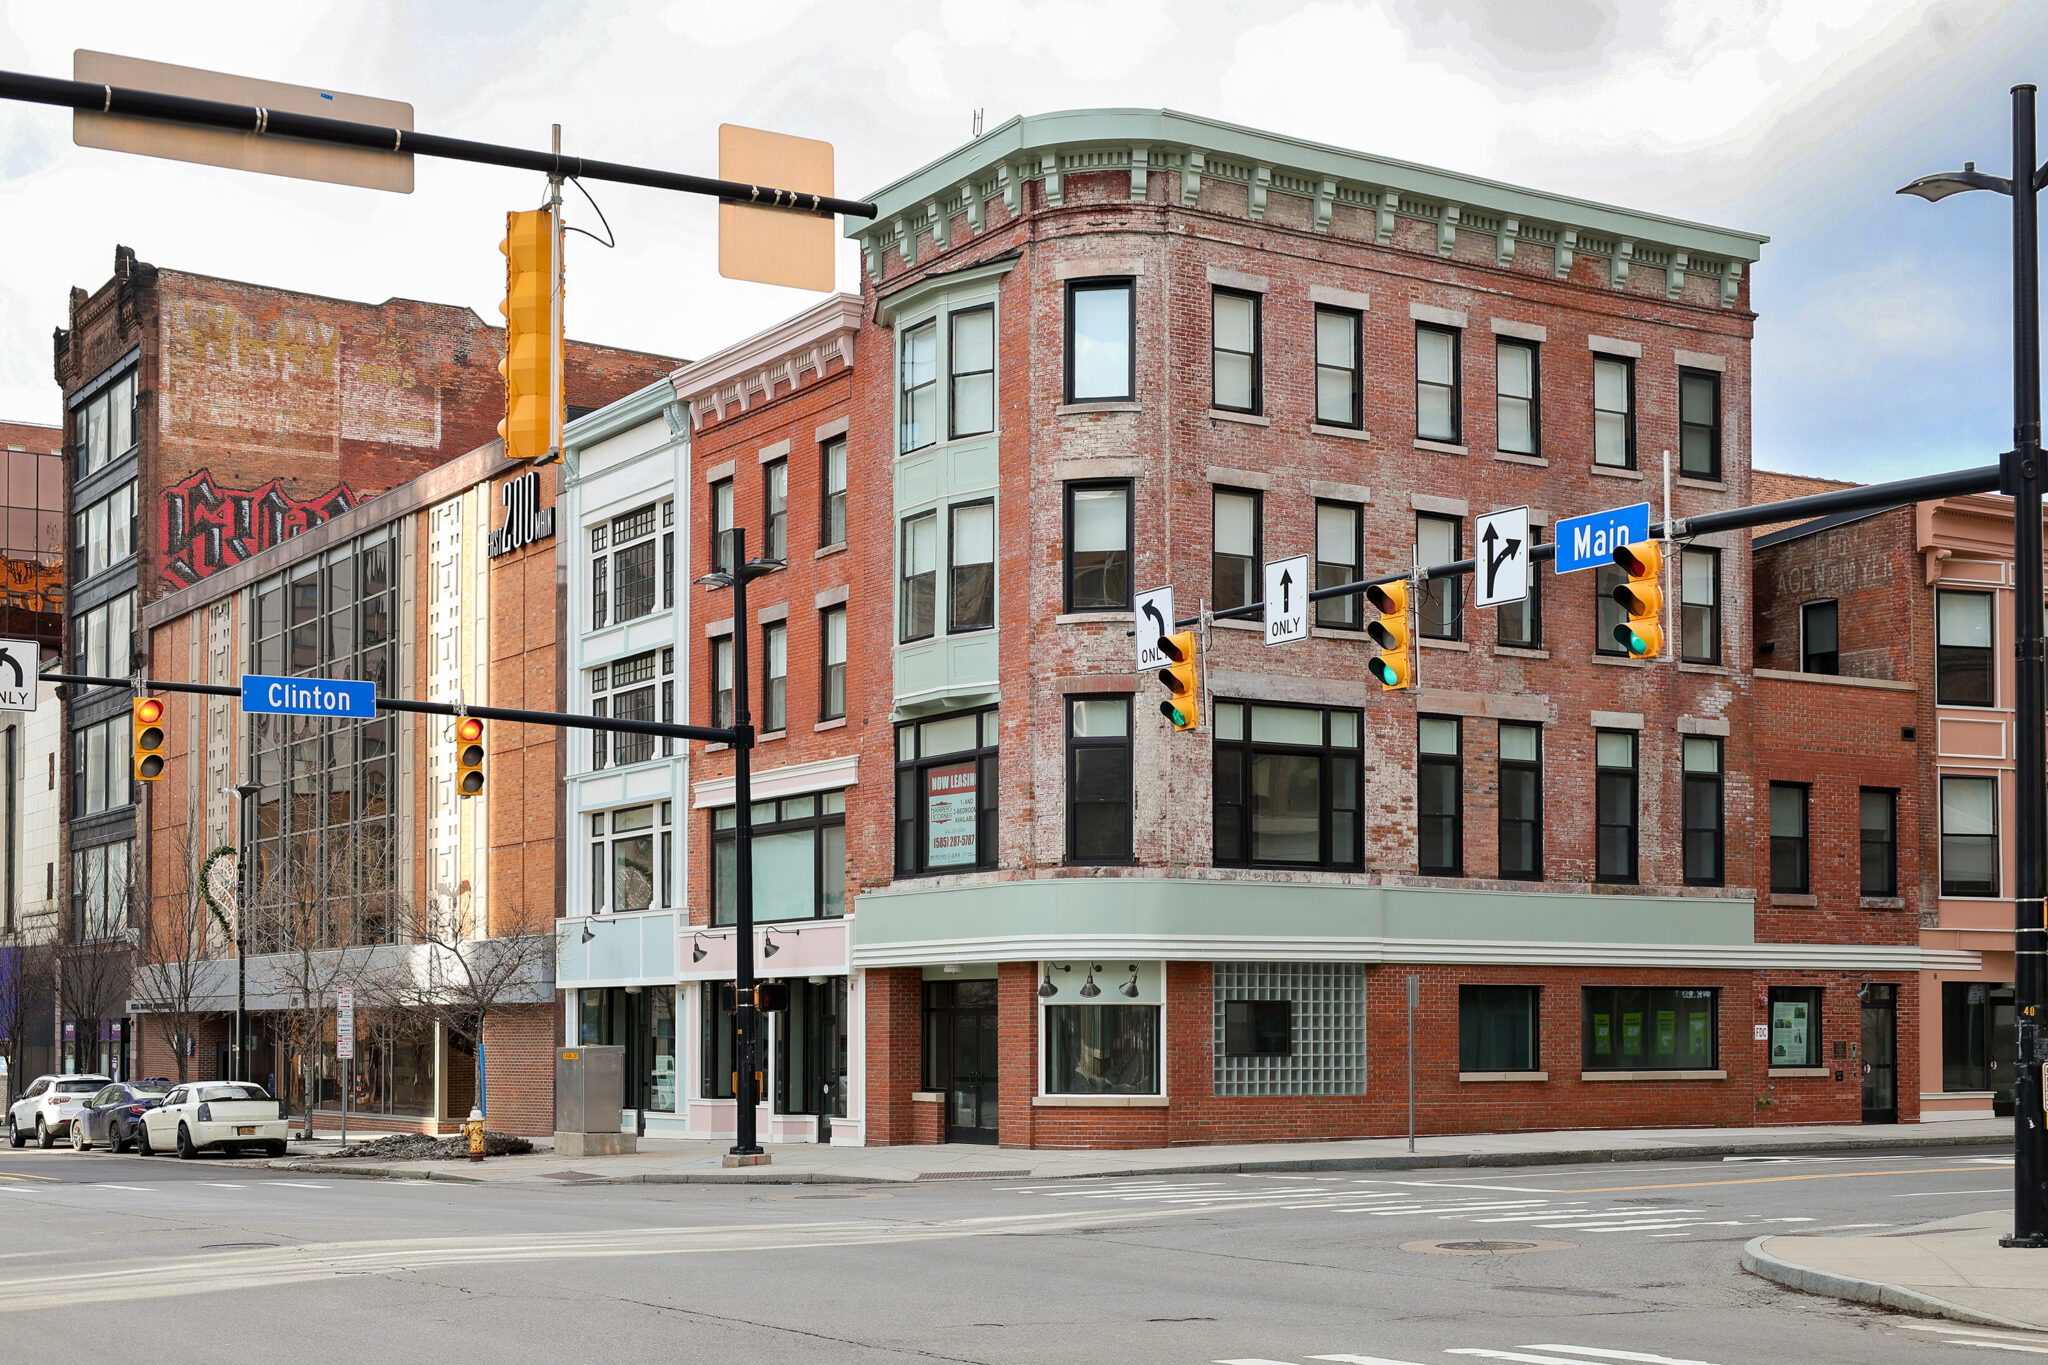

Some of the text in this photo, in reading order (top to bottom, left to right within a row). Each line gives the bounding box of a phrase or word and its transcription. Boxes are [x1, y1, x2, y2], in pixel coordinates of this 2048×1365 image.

[358, 363, 417, 389] NEWS
[488, 472, 552, 558] EAST 200 MAIN
[1574, 519, 1630, 561] Main
[1272, 616, 1300, 637] ONLY
[1141, 646, 1168, 663] ONL
[0, 690, 28, 705] NLY
[268, 683, 351, 711] Clinton
[931, 772, 976, 791] NOW LEASIN
[933, 834, 975, 848] (585) 287-5787
[2023, 1005, 2036, 1017] 40
